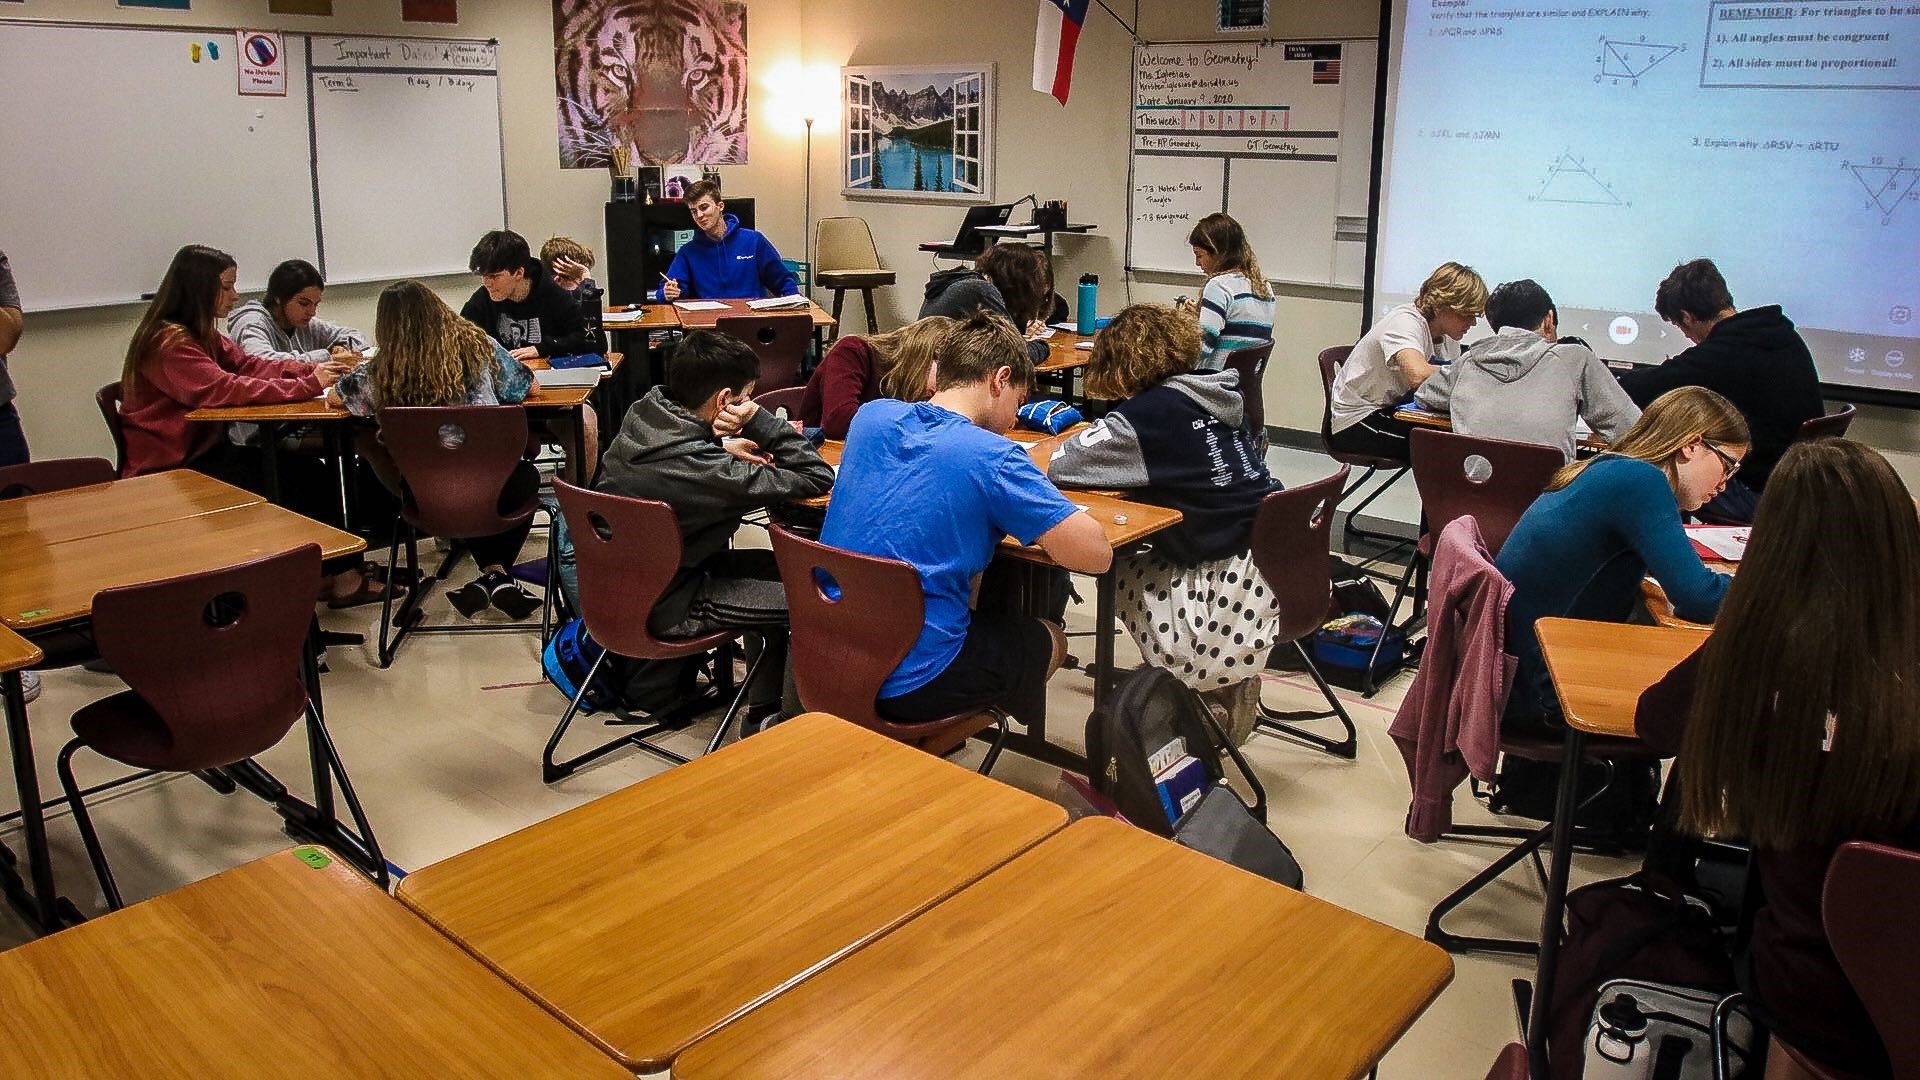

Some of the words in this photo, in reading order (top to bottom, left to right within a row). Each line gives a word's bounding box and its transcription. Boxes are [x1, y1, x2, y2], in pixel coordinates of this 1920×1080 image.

[1719, 8, 1797, 20] REMEMBER:
[1800, 7, 1821, 17] For
[1824, 7, 1872, 19] triangles
[1875, 7, 1886, 16] to
[1890, 6, 1901, 16] be
[1731, 33, 1747, 42] All
[1750, 33, 1784, 44] angles
[1787, 34, 1813, 42] must
[1817, 33, 1830, 42] be
[1833, 33, 1890, 44] congruent
[333, 40, 391, 67] Important
[1139, 51, 1185, 67] Welcome
[1187, 53, 1200, 67] to
[1203, 46, 1259, 71] Geometry!
[1728, 59, 1743, 68] All
[1746, 59, 1771, 68] sides
[1775, 59, 1802, 67] must
[1805, 59, 1818, 67] be
[319, 76, 343, 89] Term
[1154, 69, 1191, 83] Iglesias
[1165, 95, 1198, 106] January
[1213, 94, 1234, 105] 2020
[1137, 113, 1157, 126] This
[1157, 114, 1181, 127] week:
[1189, 113, 1197, 122] A
[1208, 114, 1216, 124] B
[1227, 115, 1234, 125] A
[1141, 136, 1167, 148] Pre-AP
[1168, 138, 1201, 150] Geometry
[1246, 139, 1260, 150] GT
[1262, 139, 1299, 154] Geometry
